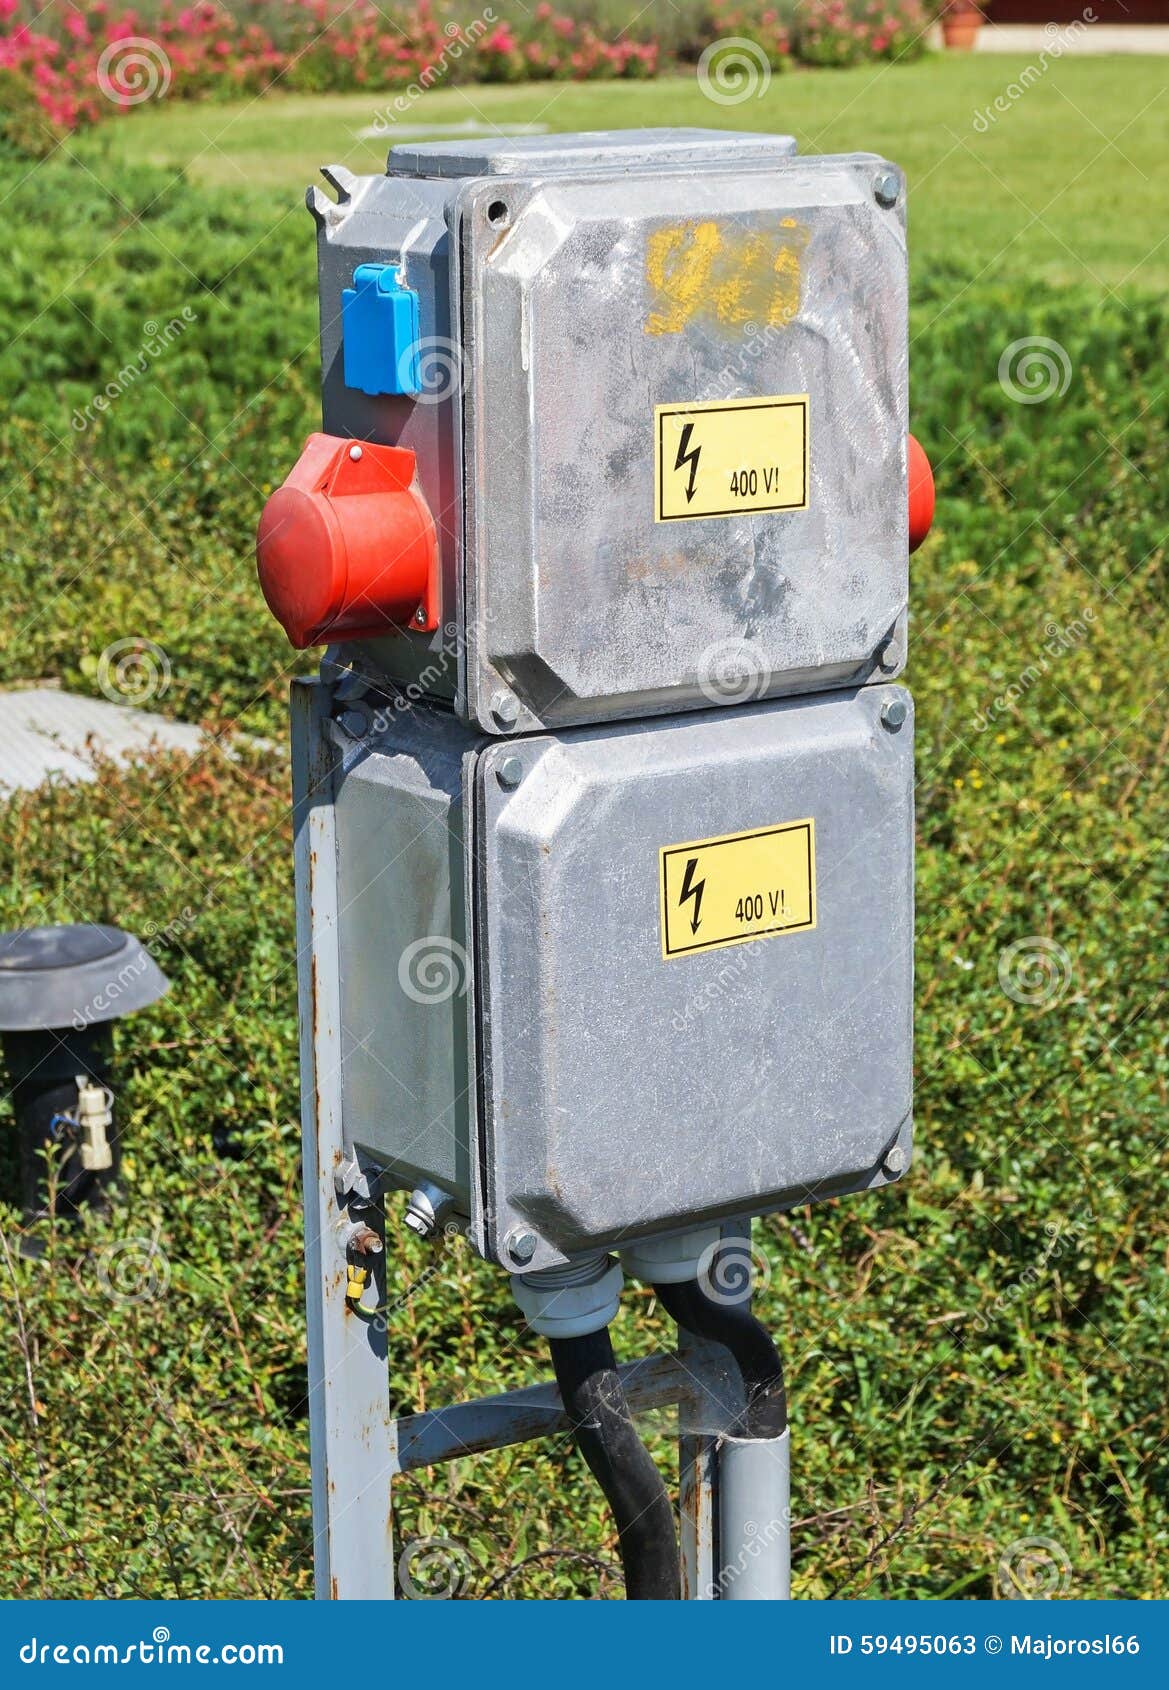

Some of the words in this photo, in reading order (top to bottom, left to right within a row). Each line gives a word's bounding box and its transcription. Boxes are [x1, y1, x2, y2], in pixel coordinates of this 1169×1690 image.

[730, 469, 757, 497] 400
[763, 467, 779, 494] V!
[735, 894, 762, 922] 400
[768, 889, 784, 916] V!
